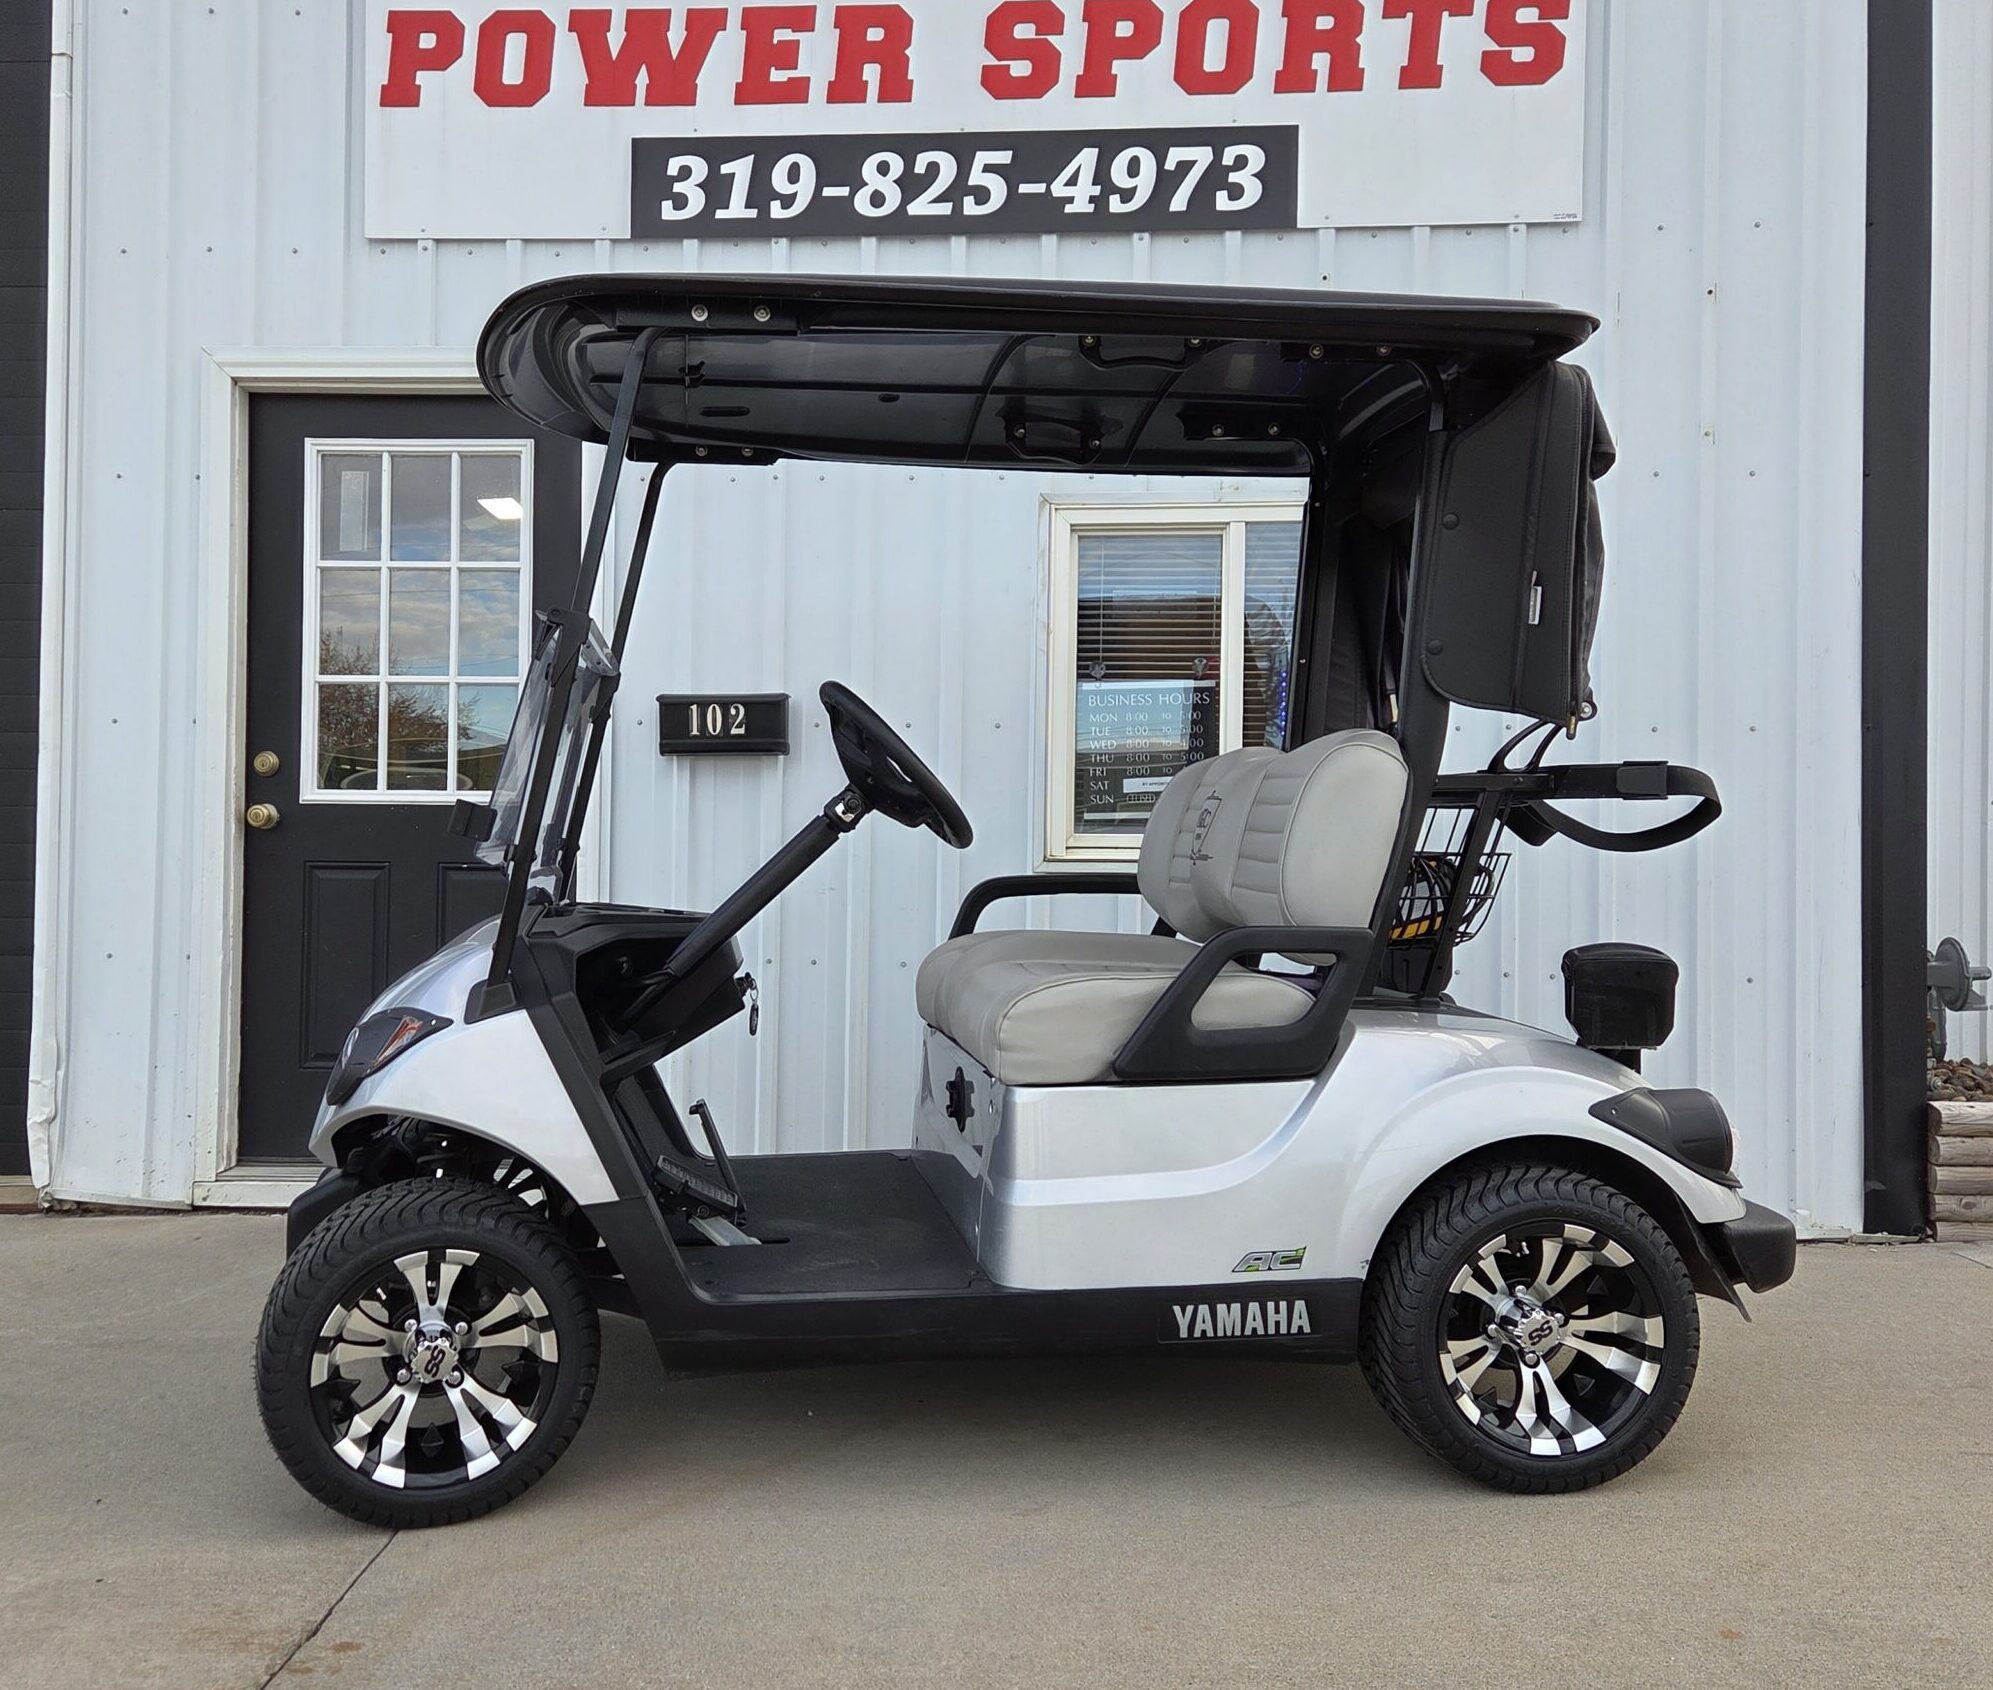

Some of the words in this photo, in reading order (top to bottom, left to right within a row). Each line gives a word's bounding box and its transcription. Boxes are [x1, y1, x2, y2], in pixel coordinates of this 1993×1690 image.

[379, 4, 915, 108] POWER
[980, 0, 1571, 100] SPORTS
[660, 144, 1266, 220] 319-825-4973
[1088, 693, 1153, 707] BUSINESS
[1159, 691, 1210, 705] HOURS
[688, 703, 746, 736] 102
[1089, 712, 1118, 723] MON
[1090, 726, 1111, 736] TUE
[1089, 740, 1117, 750] WED
[1090, 753, 1114, 763] THU
[1126, 752, 1150, 763] 8:00
[1180, 751, 1204, 761] 5:00
[1089, 766, 1107, 777] FRI
[1126, 766, 1150, 776] 8:00
[1090, 780, 1110, 791] SAT
[1090, 794, 1114, 805] SUN
[1172, 1300, 1312, 1339] YAMAHA
